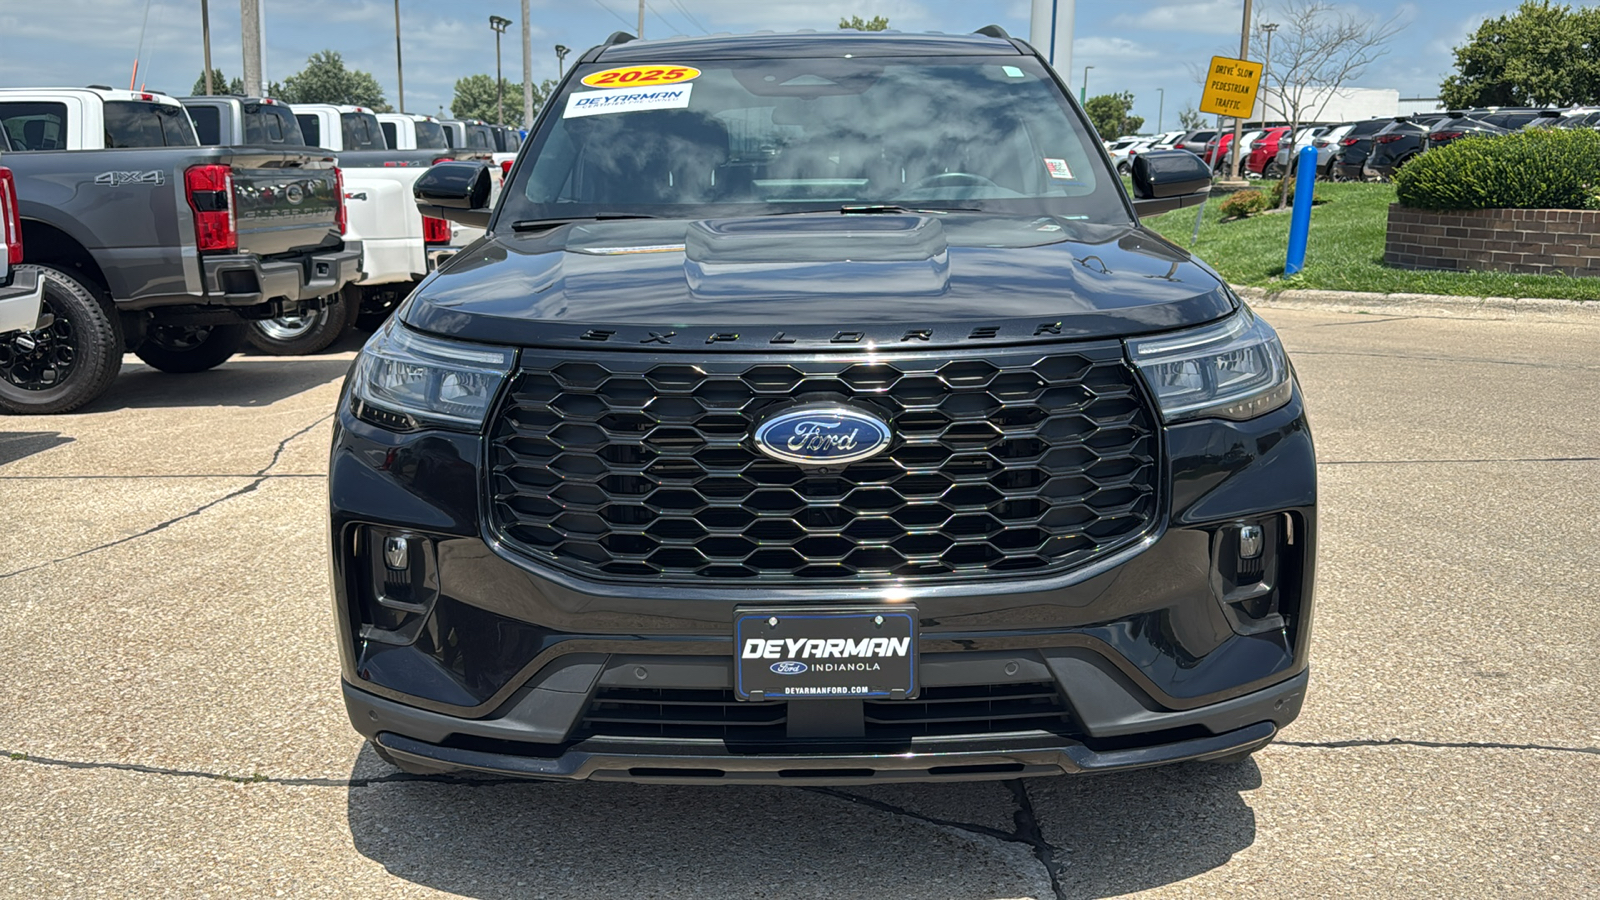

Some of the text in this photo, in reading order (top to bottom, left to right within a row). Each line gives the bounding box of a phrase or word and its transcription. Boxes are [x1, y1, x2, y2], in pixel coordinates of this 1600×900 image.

[593, 68, 688, 84] 2025
[1215, 65, 1253, 78] DRIVE SLOW
[1211, 81, 1249, 94] PEDESTRIAN
[575, 91, 683, 106] DEYARMAN
[1215, 97, 1241, 110] TRAFFIC
[580, 321, 1062, 344] EXPLORER
[787, 421, 859, 451] Ford
[741, 637, 911, 659] DEYARMAN
[777, 663, 881, 673] Ford INDIANOLA
[785, 686, 868, 695] DEYARMANFORD.COM
